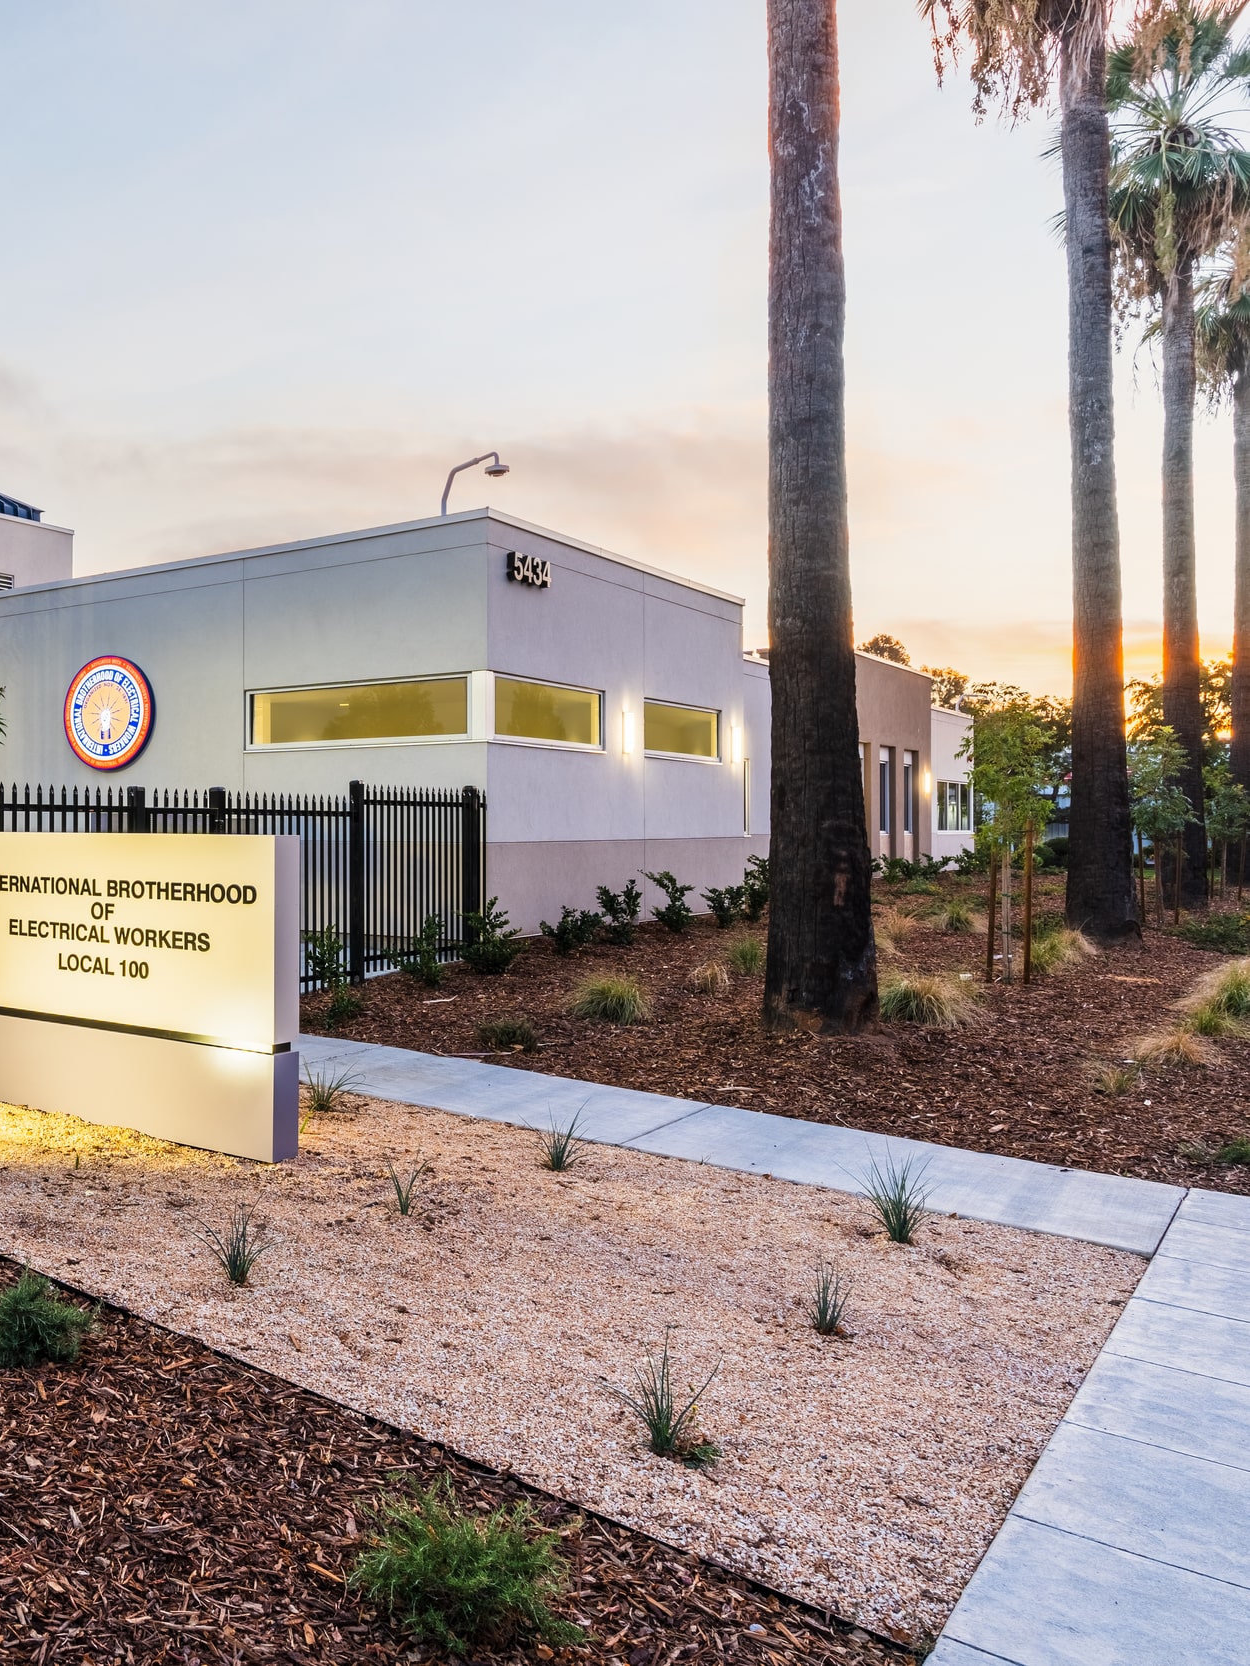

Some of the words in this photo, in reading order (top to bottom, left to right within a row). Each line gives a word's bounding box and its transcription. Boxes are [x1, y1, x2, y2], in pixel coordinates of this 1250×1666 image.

[508, 551, 552, 588] 5434
[76, 670, 114, 705] BROTHERHOOD
[114, 672, 124, 684] OF
[121, 678, 141, 722] ELECTRICAL
[108, 724, 137, 754] WORKERS
[107, 879, 257, 905] BROTHERHOOD
[90, 902, 115, 921] OF
[9, 918, 110, 944] ELECTRICAL
[114, 927, 211, 952] WORKERS
[58, 953, 115, 976] LOCAL
[119, 960, 150, 979] 100
